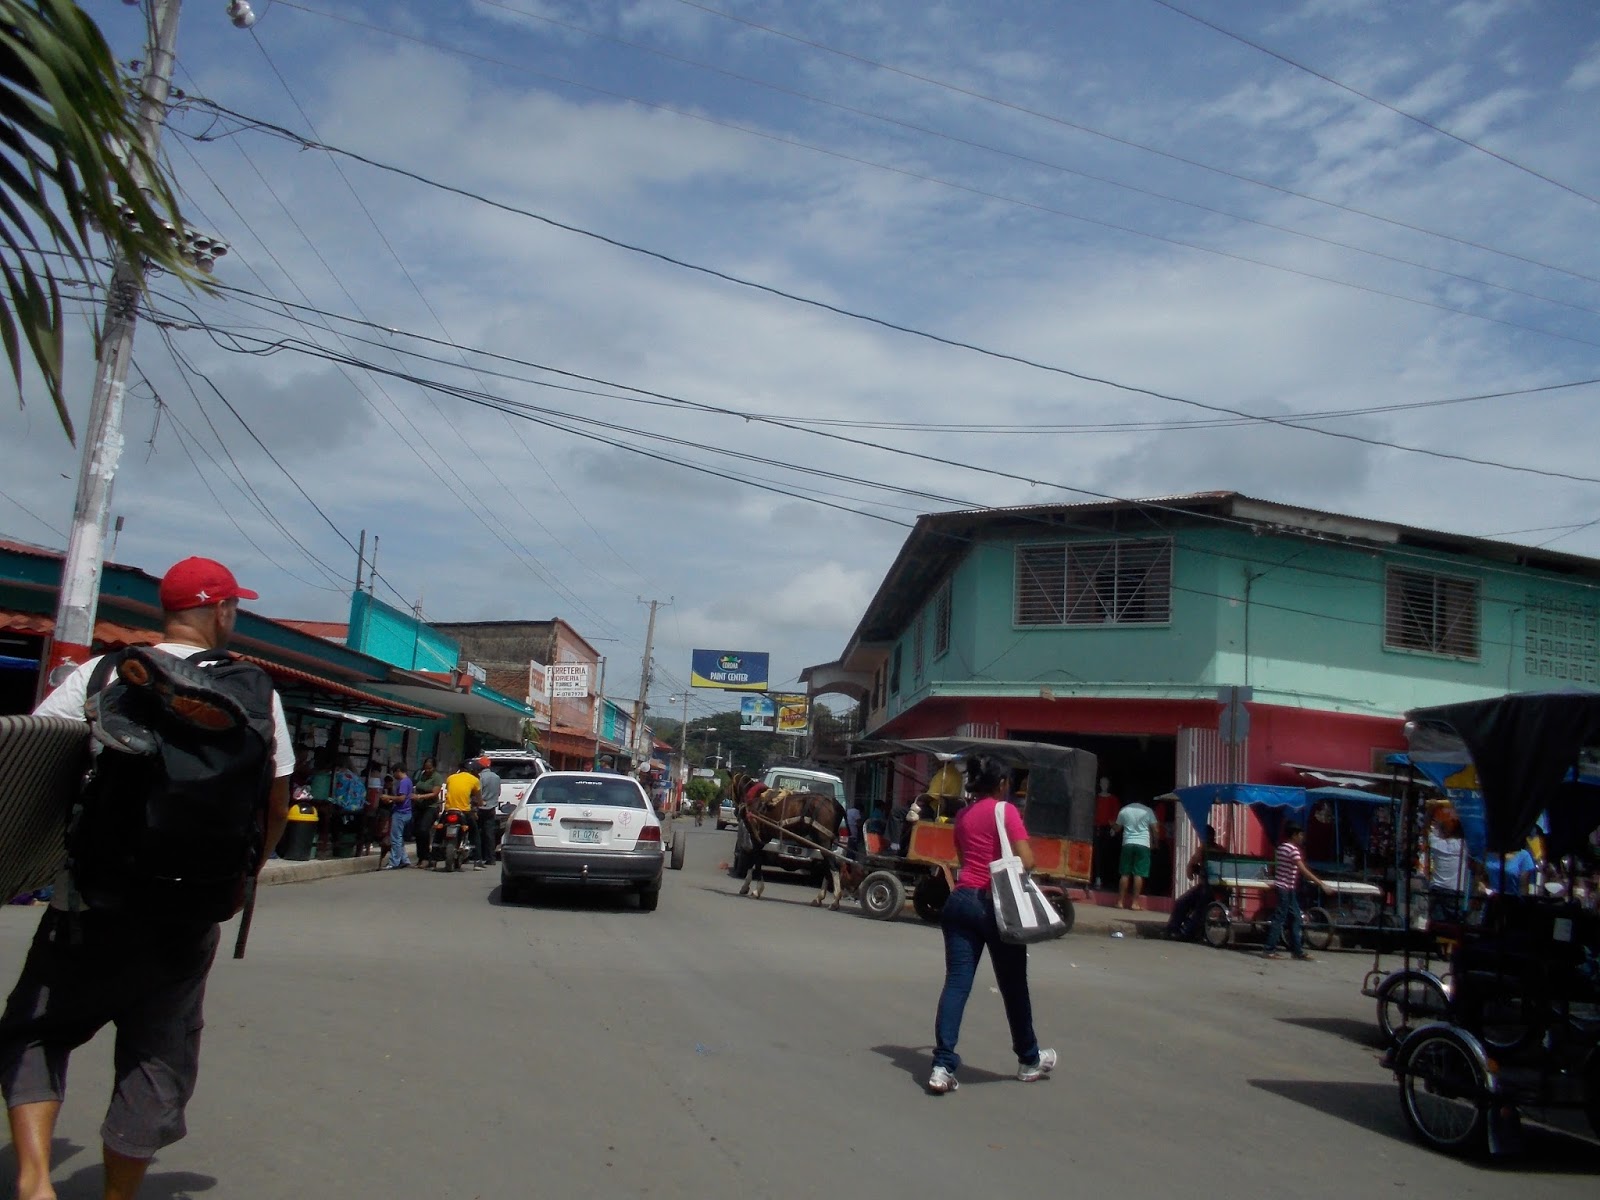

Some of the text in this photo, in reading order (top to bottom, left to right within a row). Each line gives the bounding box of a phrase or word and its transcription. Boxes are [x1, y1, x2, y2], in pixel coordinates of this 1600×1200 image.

[710, 671, 749, 682] PAINT CENTER
[583, 831, 599, 839] 0276
